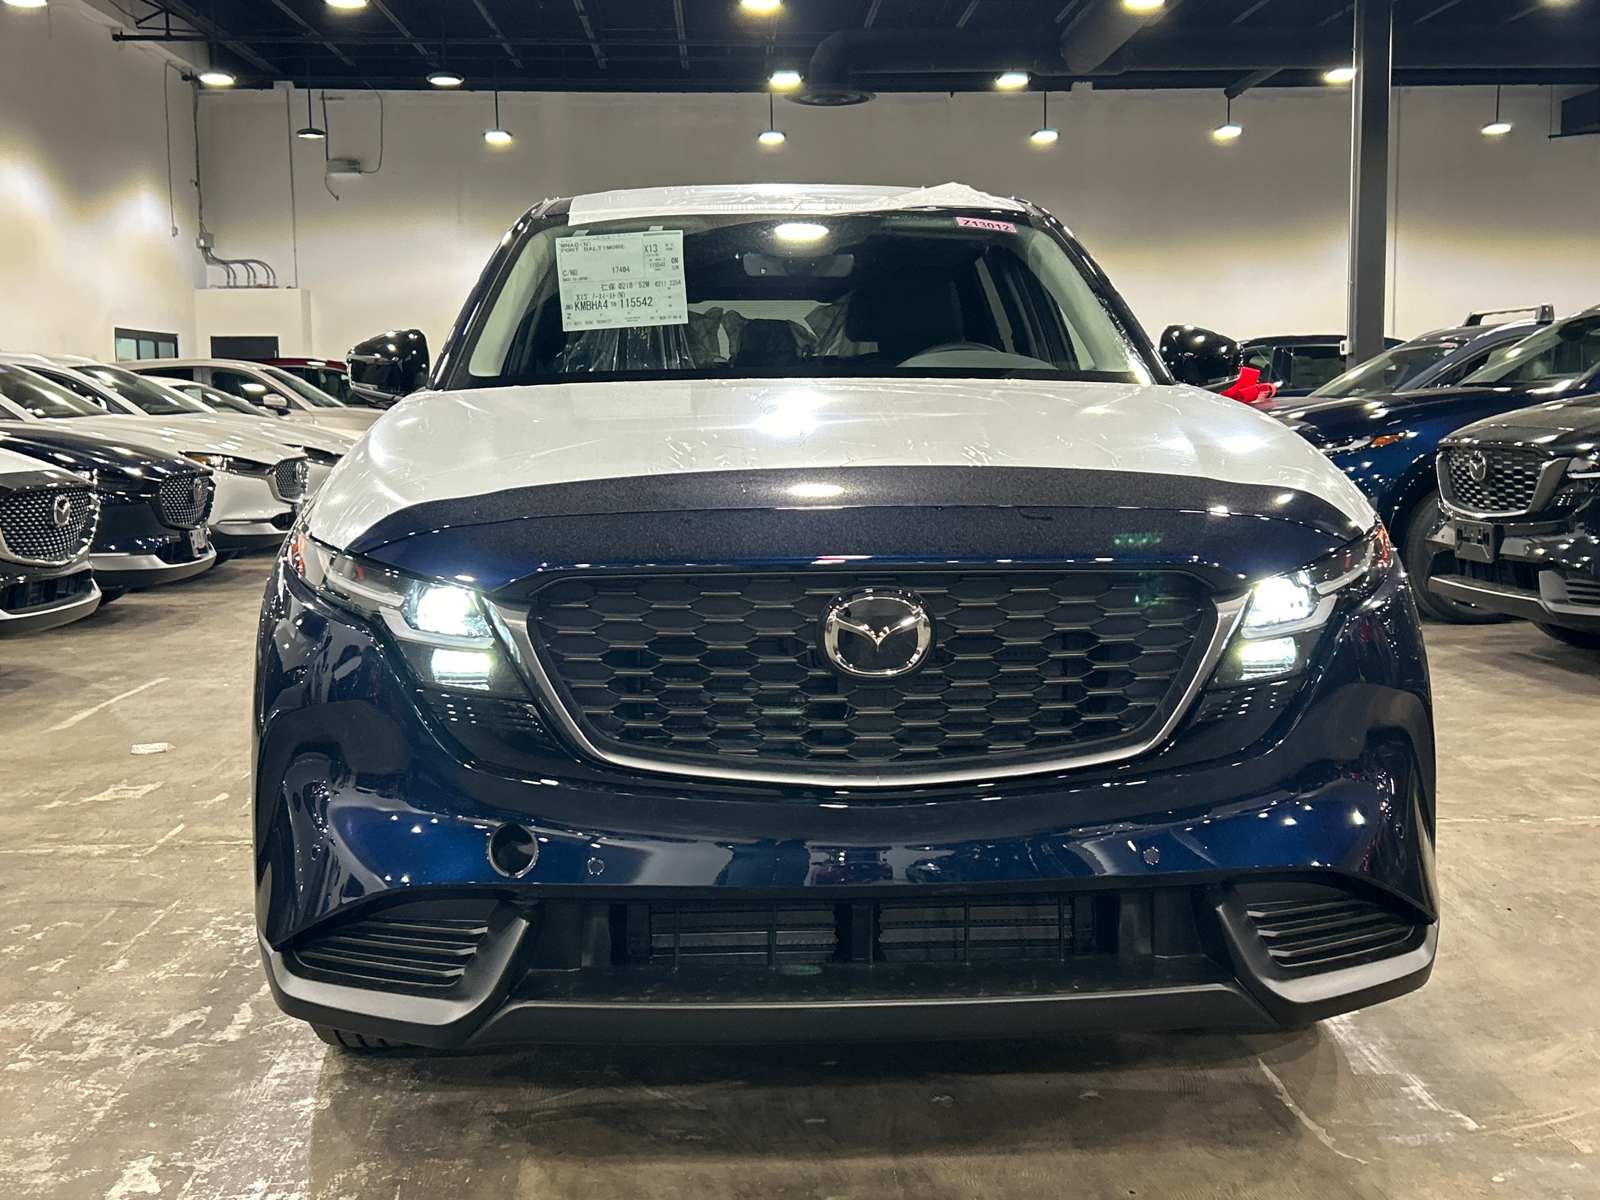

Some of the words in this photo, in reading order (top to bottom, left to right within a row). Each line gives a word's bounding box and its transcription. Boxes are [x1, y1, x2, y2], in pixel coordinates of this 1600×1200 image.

[643, 243, 658, 253] X13
[574, 299, 609, 311] KMBHA4
[620, 296, 653, 308] 115542
